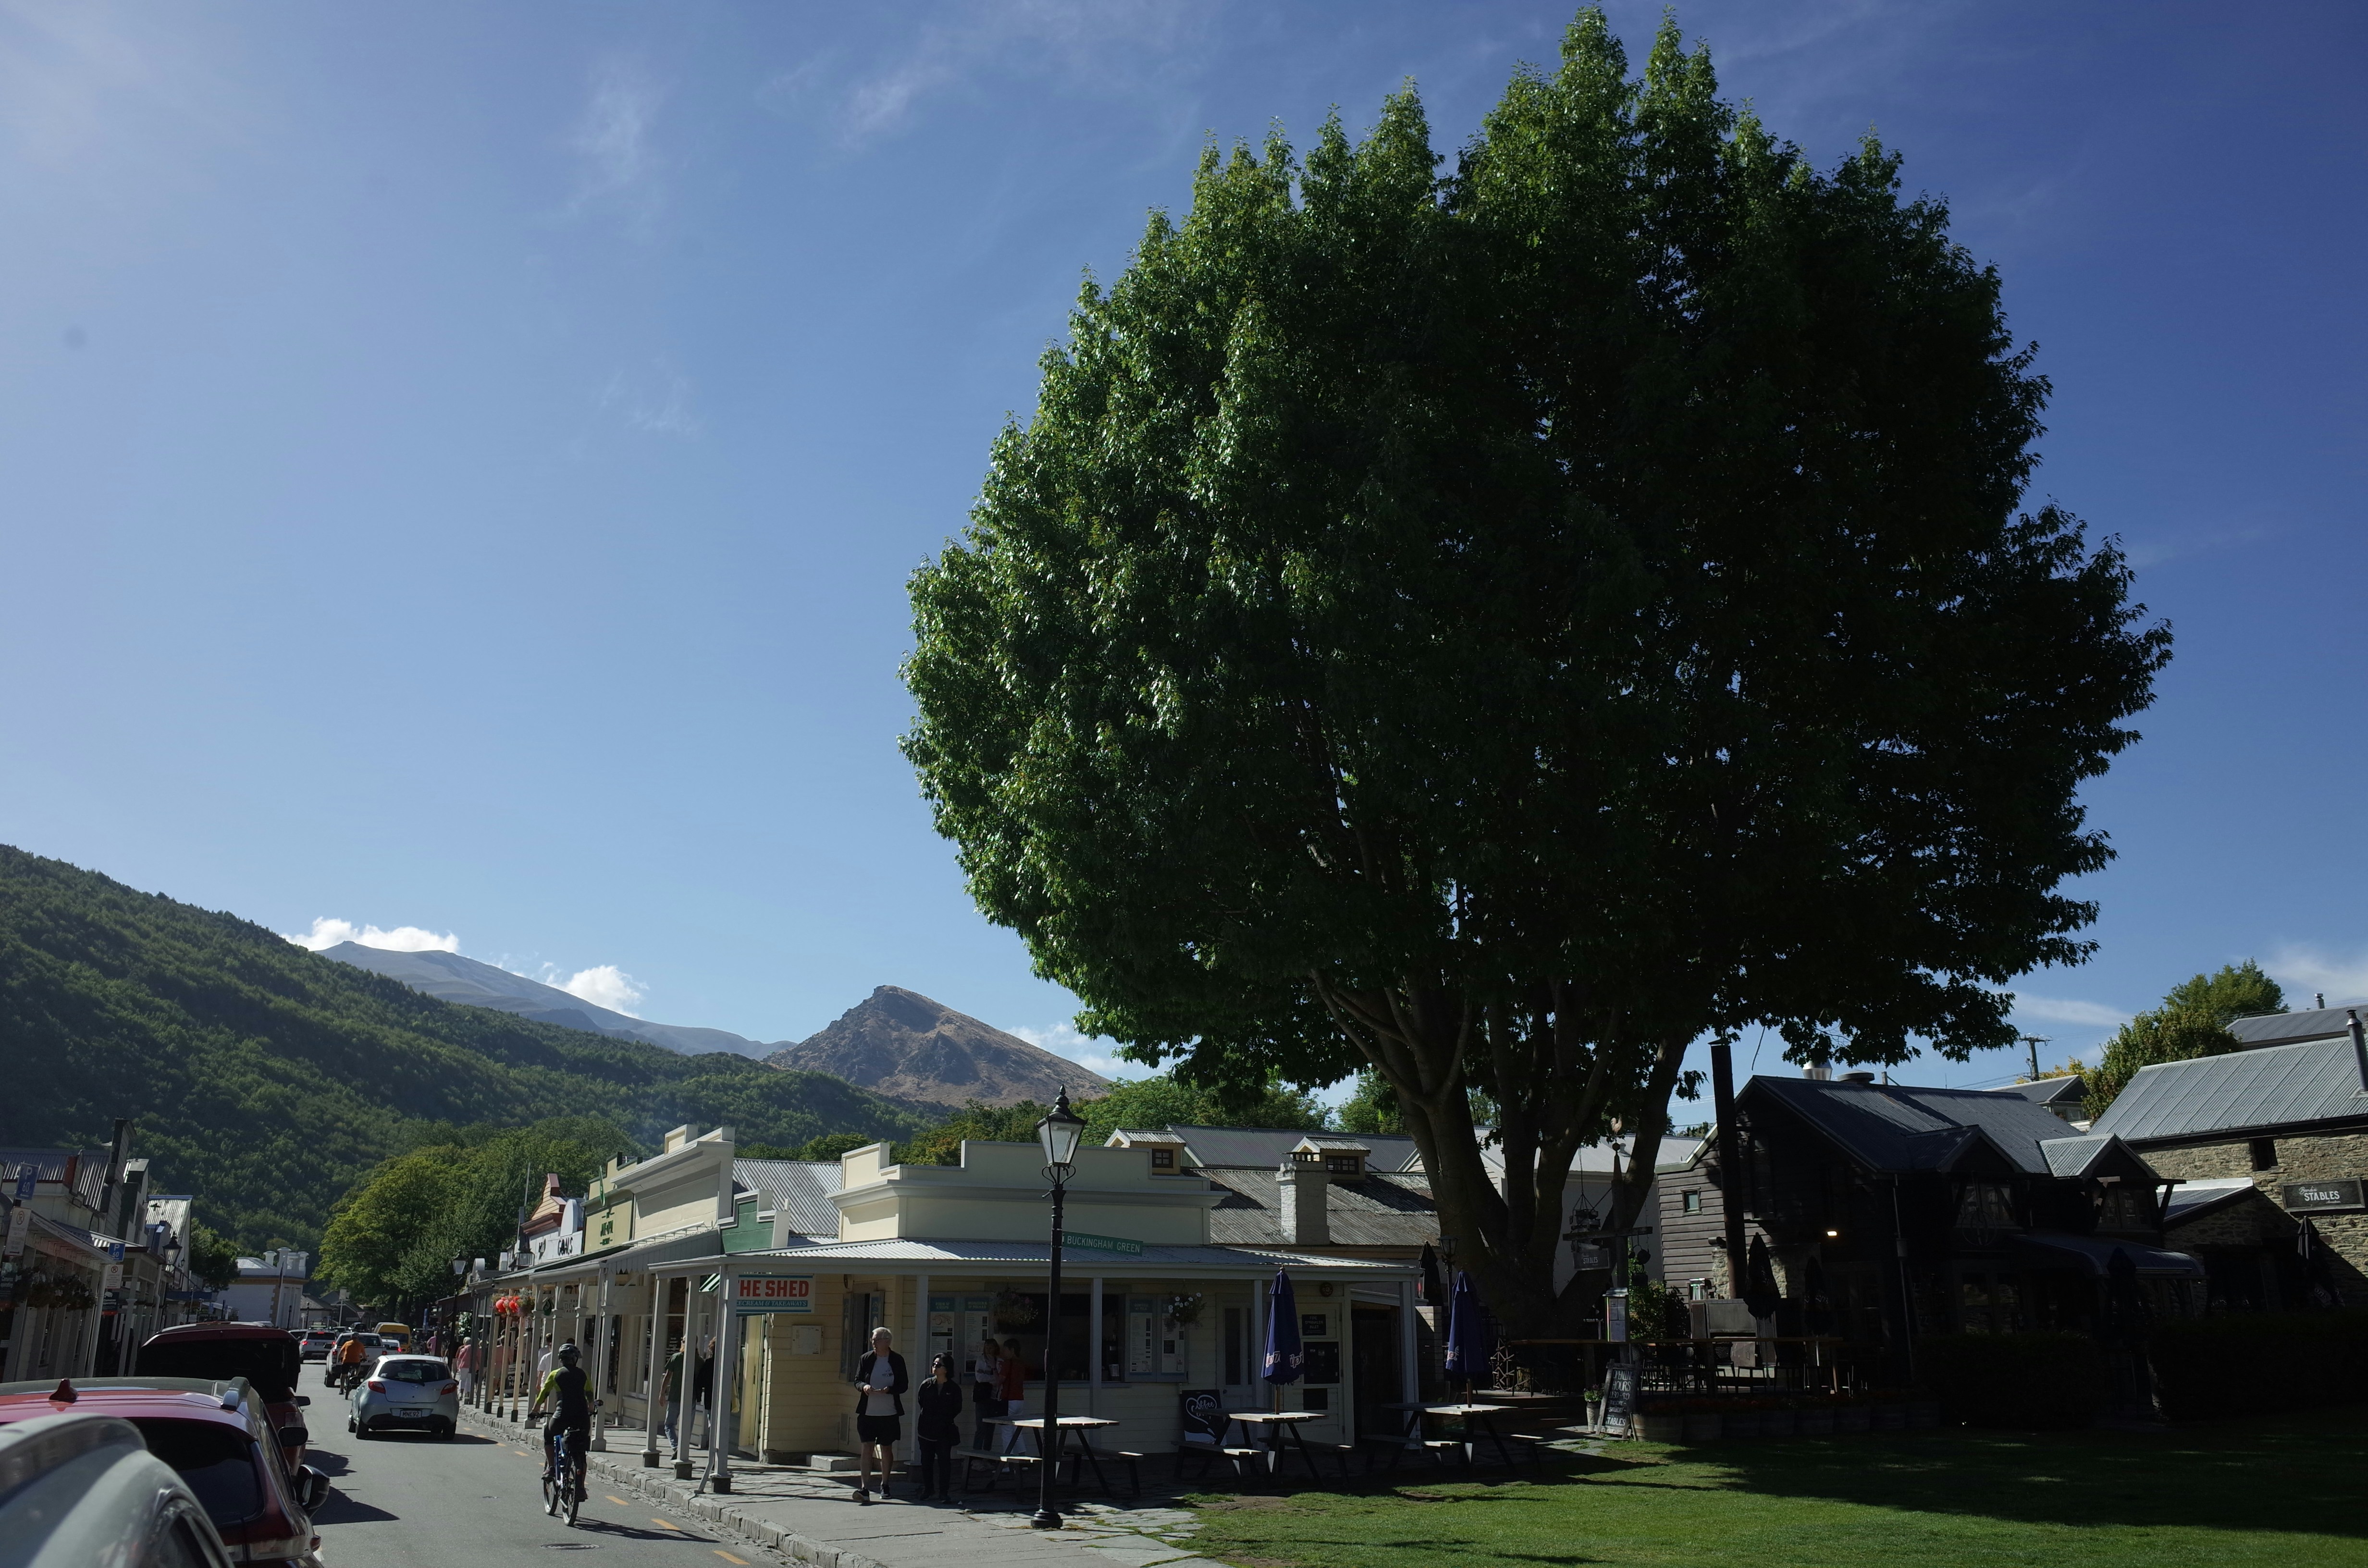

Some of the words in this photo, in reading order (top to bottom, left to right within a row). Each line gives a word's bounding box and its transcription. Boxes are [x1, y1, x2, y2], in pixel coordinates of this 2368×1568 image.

[25, 1166, 32, 1179] P
[22, 1182, 30, 1192] 60
[2304, 1190, 2340, 1201] STABLES
[1067, 1236, 1113, 1250] BUCKINGHAM
[1117, 1242, 1140, 1253] GREEN
[738, 1280, 761, 1297] HE
[765, 1280, 809, 1297] SHED
[1612, 1381, 1631, 1391] HOURS
